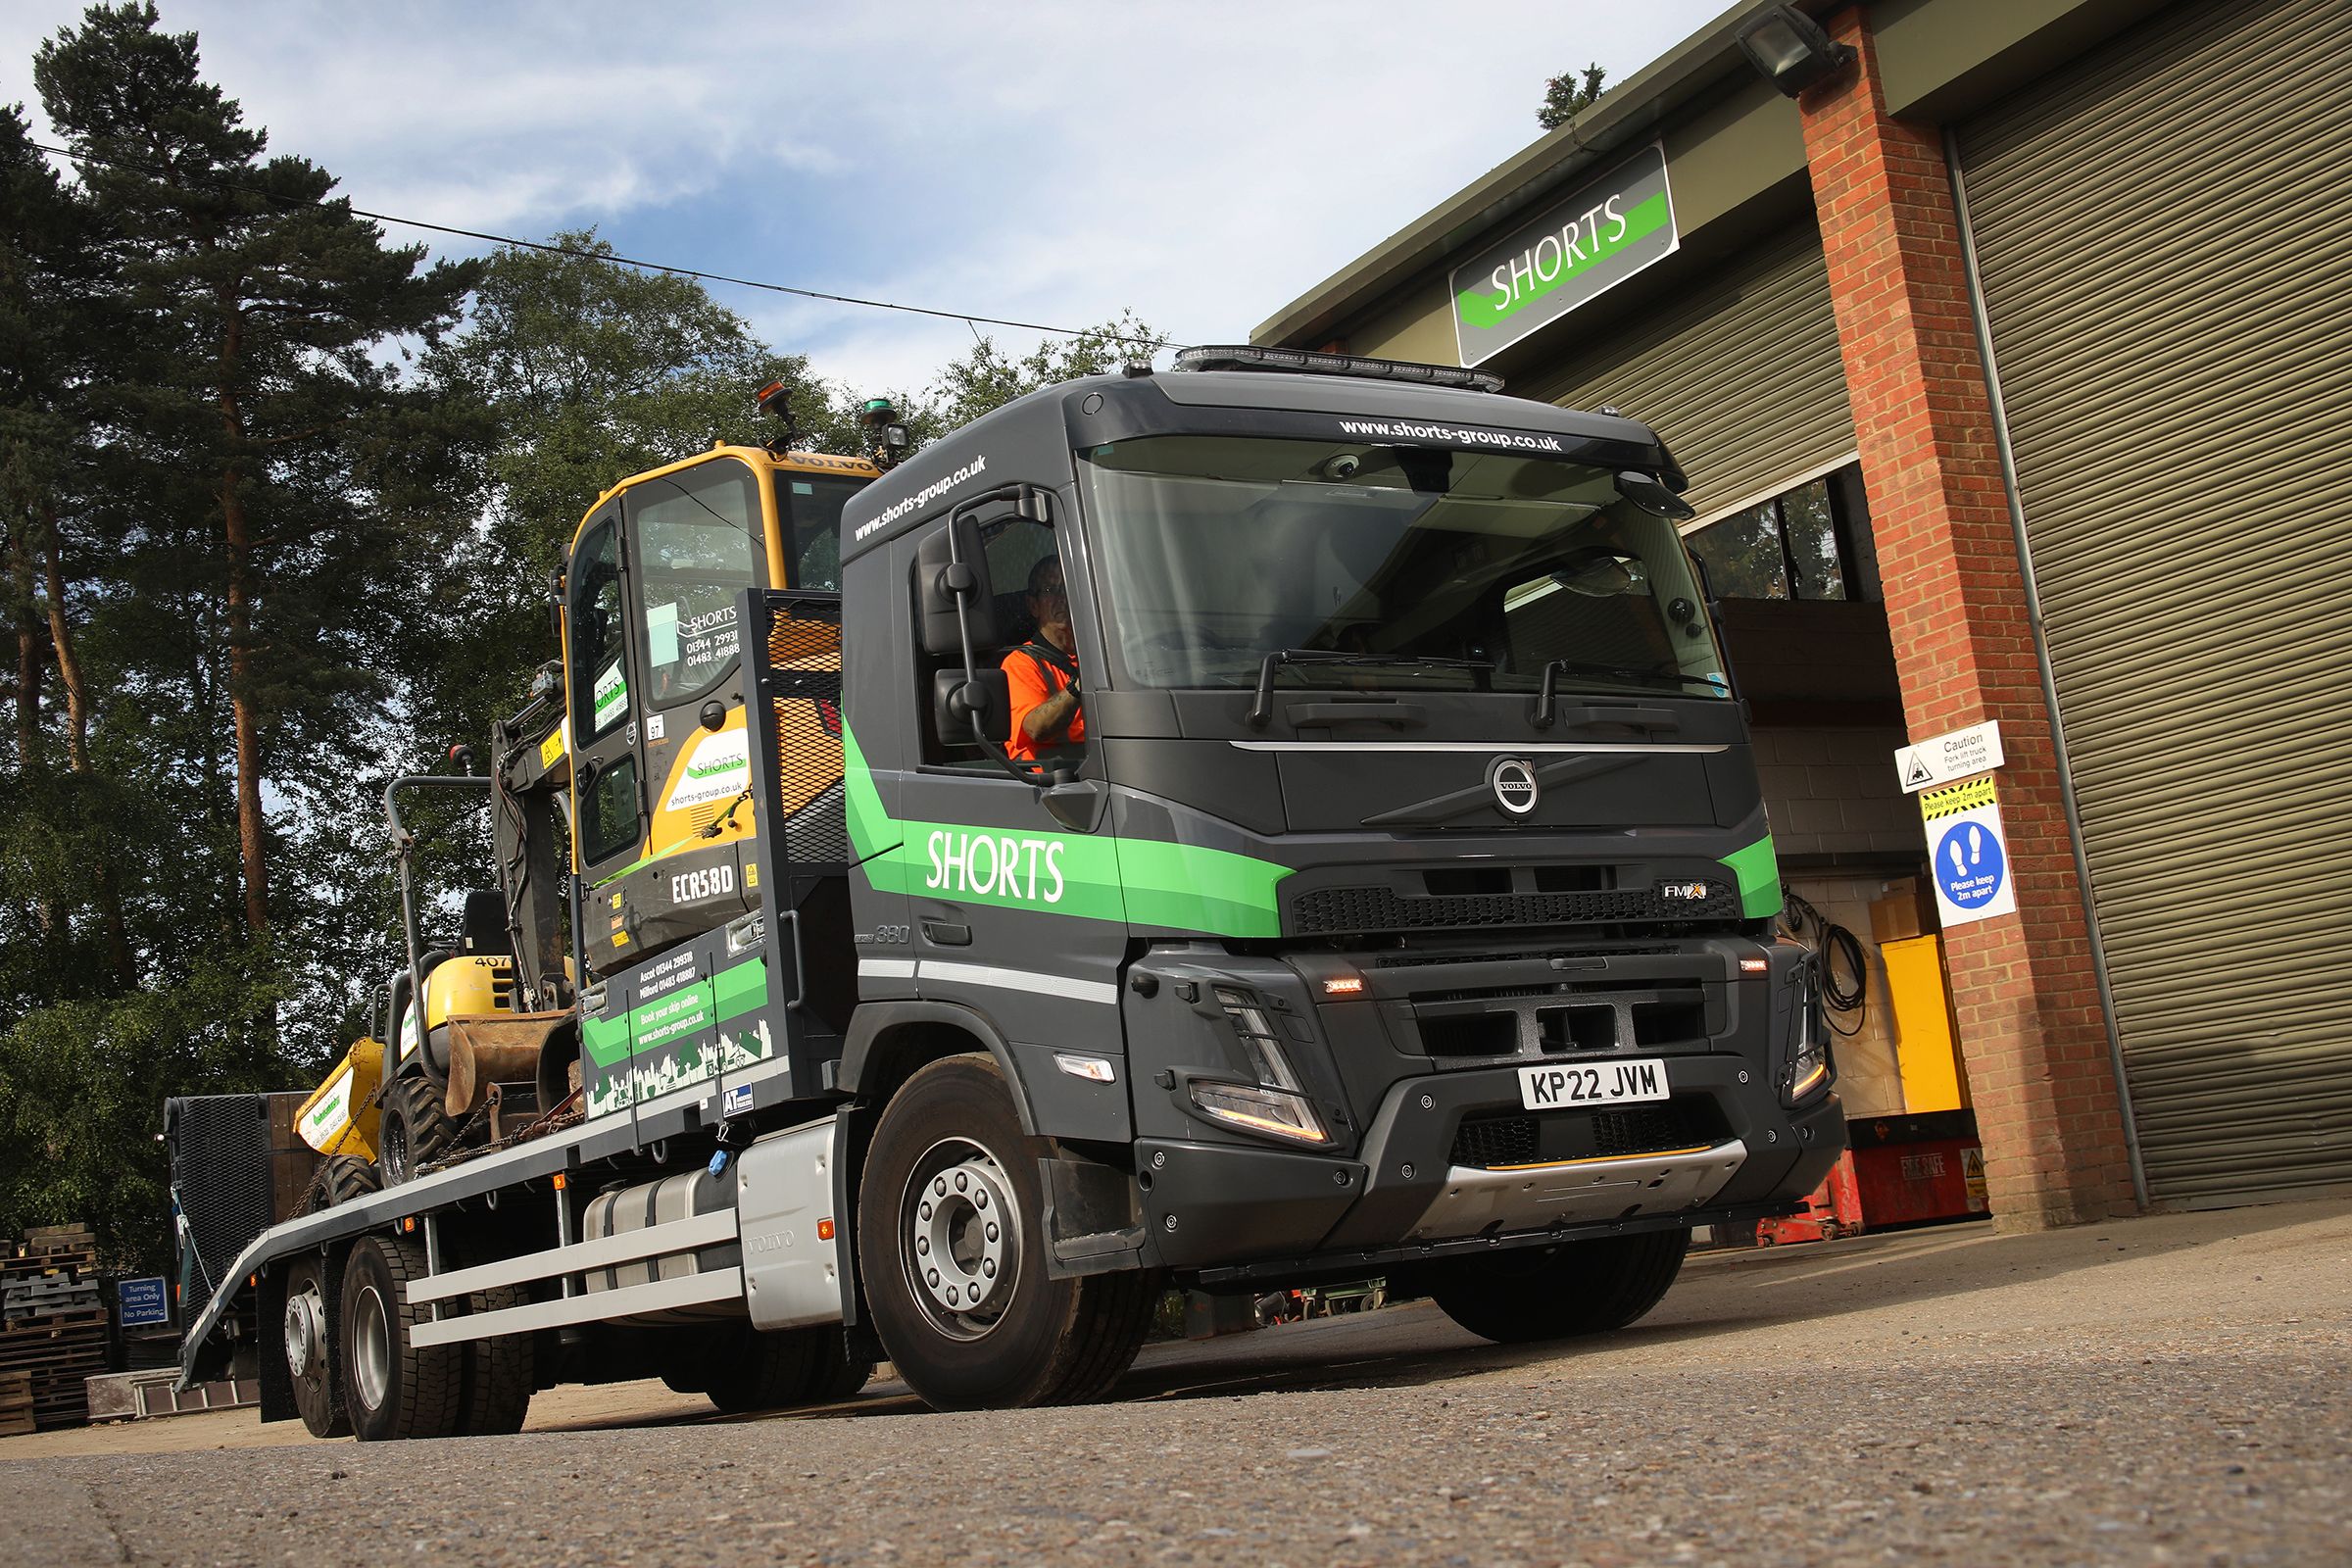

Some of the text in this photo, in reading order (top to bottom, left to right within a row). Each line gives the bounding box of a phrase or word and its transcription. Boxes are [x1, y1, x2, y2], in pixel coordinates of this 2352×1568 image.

[1491, 194, 1627, 311] SHORTS
[1339, 420, 1563, 452] www.shorts-group.co.uk
[790, 456, 873, 471] VOLVO
[855, 455, 986, 541] www.shorts-group.co.uk
[690, 606, 737, 630] SHORTS
[686, 630, 738, 654] 01344 29931
[687, 643, 740, 666] 01483 41888
[595, 676, 620, 708] ORTS
[651, 725, 660, 738] 97
[1943, 734, 1984, 753] Caution
[698, 753, 744, 776] SHORTS
[1944, 755, 1959, 763] Fork
[1969, 747, 1986, 757] truck
[1947, 756, 1986, 771] turning area
[671, 782, 743, 807] shorts-group.co.uk
[1925, 787, 1992, 810] Please keep 2m apart
[926, 830, 1064, 904] SHORTS
[671, 864, 734, 904] ECR58D
[1950, 874, 1995, 891] Please keep
[1957, 885, 1993, 901] 2m apart
[877, 925, 909, 944] 380
[640, 968, 656, 983] Ascot
[656, 959, 673, 976] 01344
[639, 981, 659, 1000] Milford
[659, 974, 676, 992] 01483
[640, 994, 699, 1025] Book your skip online
[638, 1010, 705, 1046] www.shorts-group.co.uk
[1531, 1064, 1658, 1103] KP22 JVM
[745, 1230, 795, 1254] VOLVO
[128, 1284, 156, 1293] Turning
